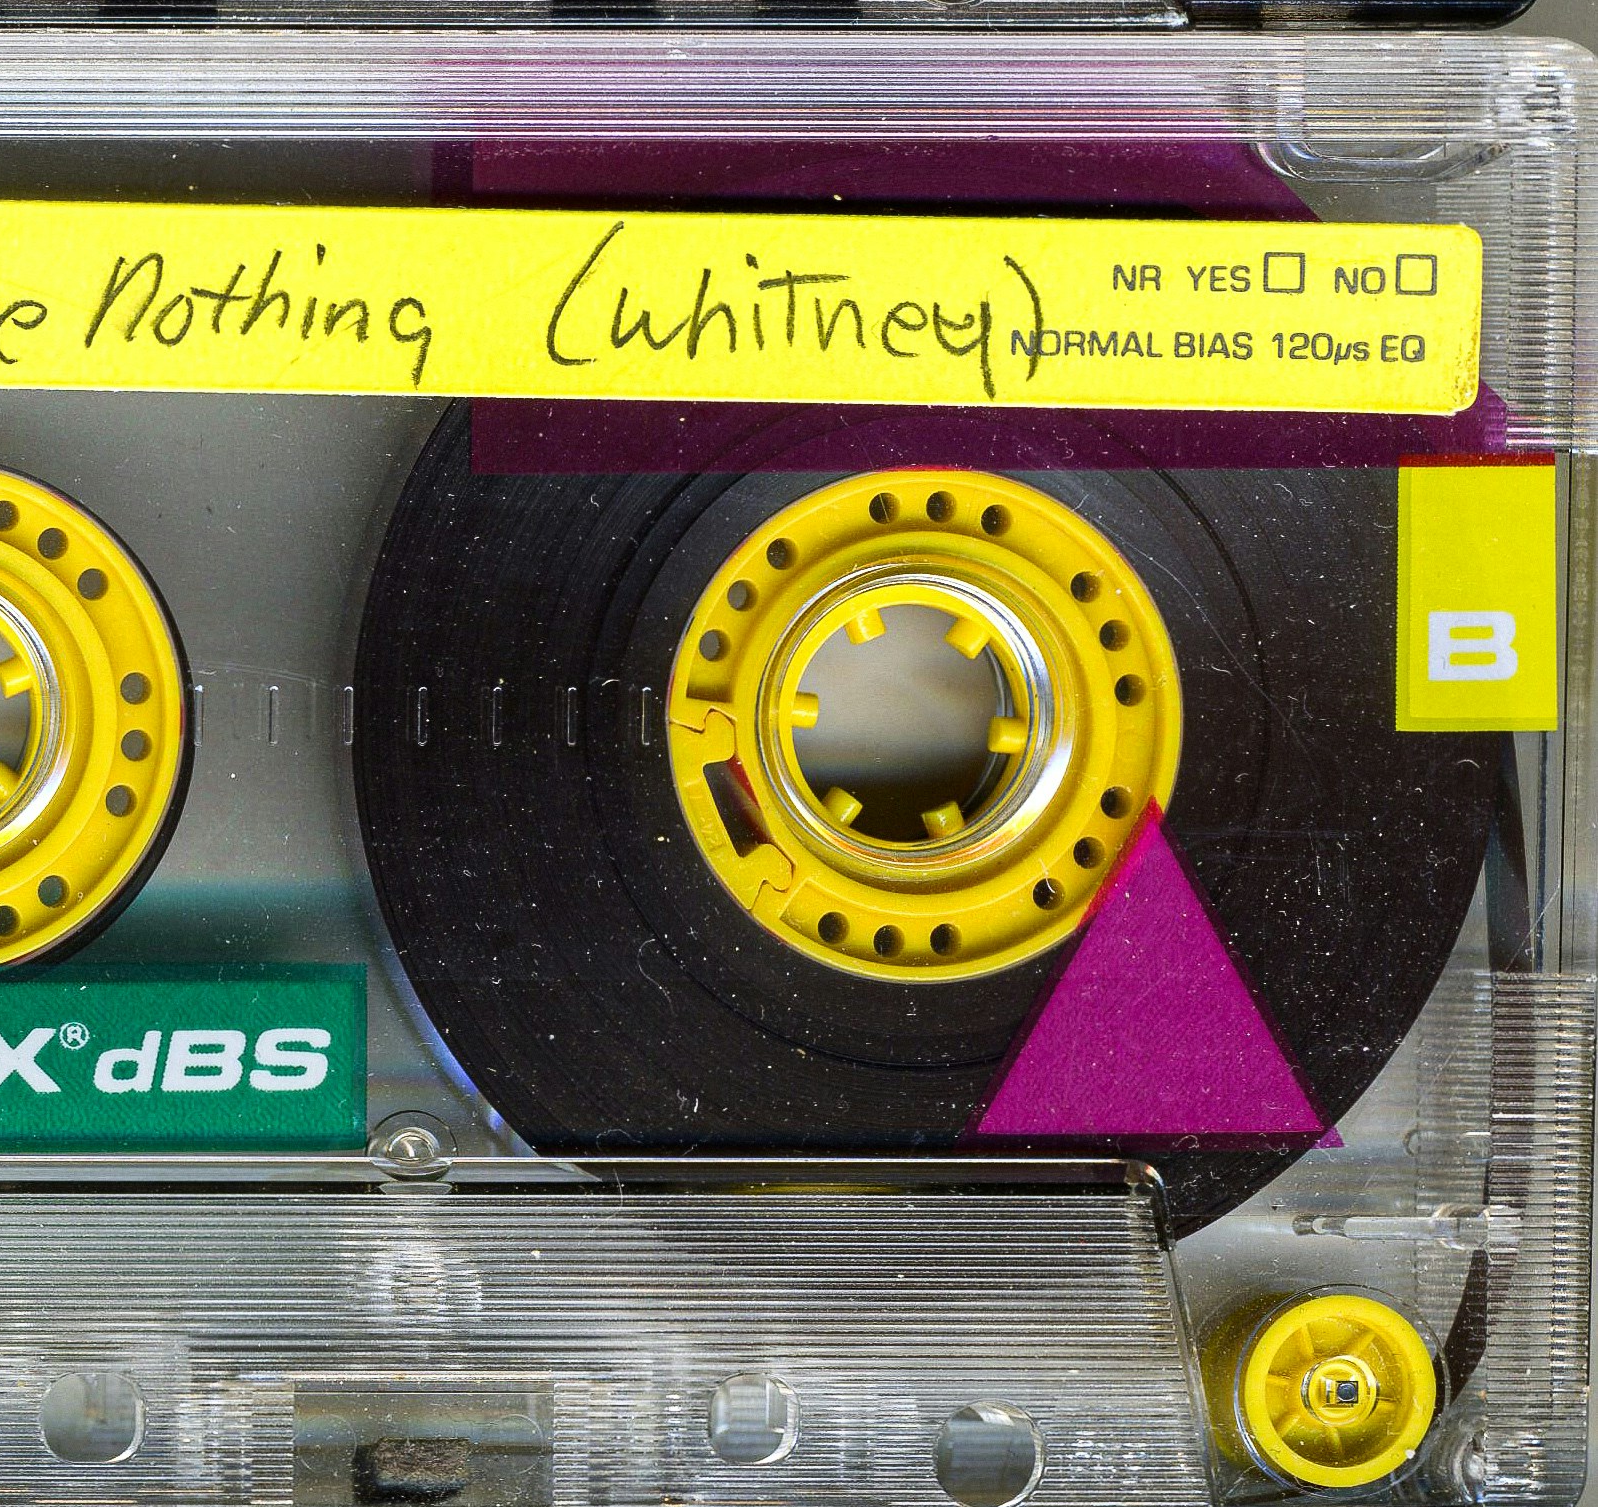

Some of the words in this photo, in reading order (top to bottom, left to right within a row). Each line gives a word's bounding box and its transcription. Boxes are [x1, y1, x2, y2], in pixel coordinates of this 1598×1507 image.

[1113, 265, 1162, 291] NR
[1187, 265, 1251, 292] YES
[1334, 267, 1385, 294] NO
[1011, 329, 1163, 358] NORMAL
[1174, 332, 1253, 359] BIAS
[1381, 335, 1426, 362] EQ
[1428, 610, 1518, 682] B
[92, 1026, 332, 1095] dBS
